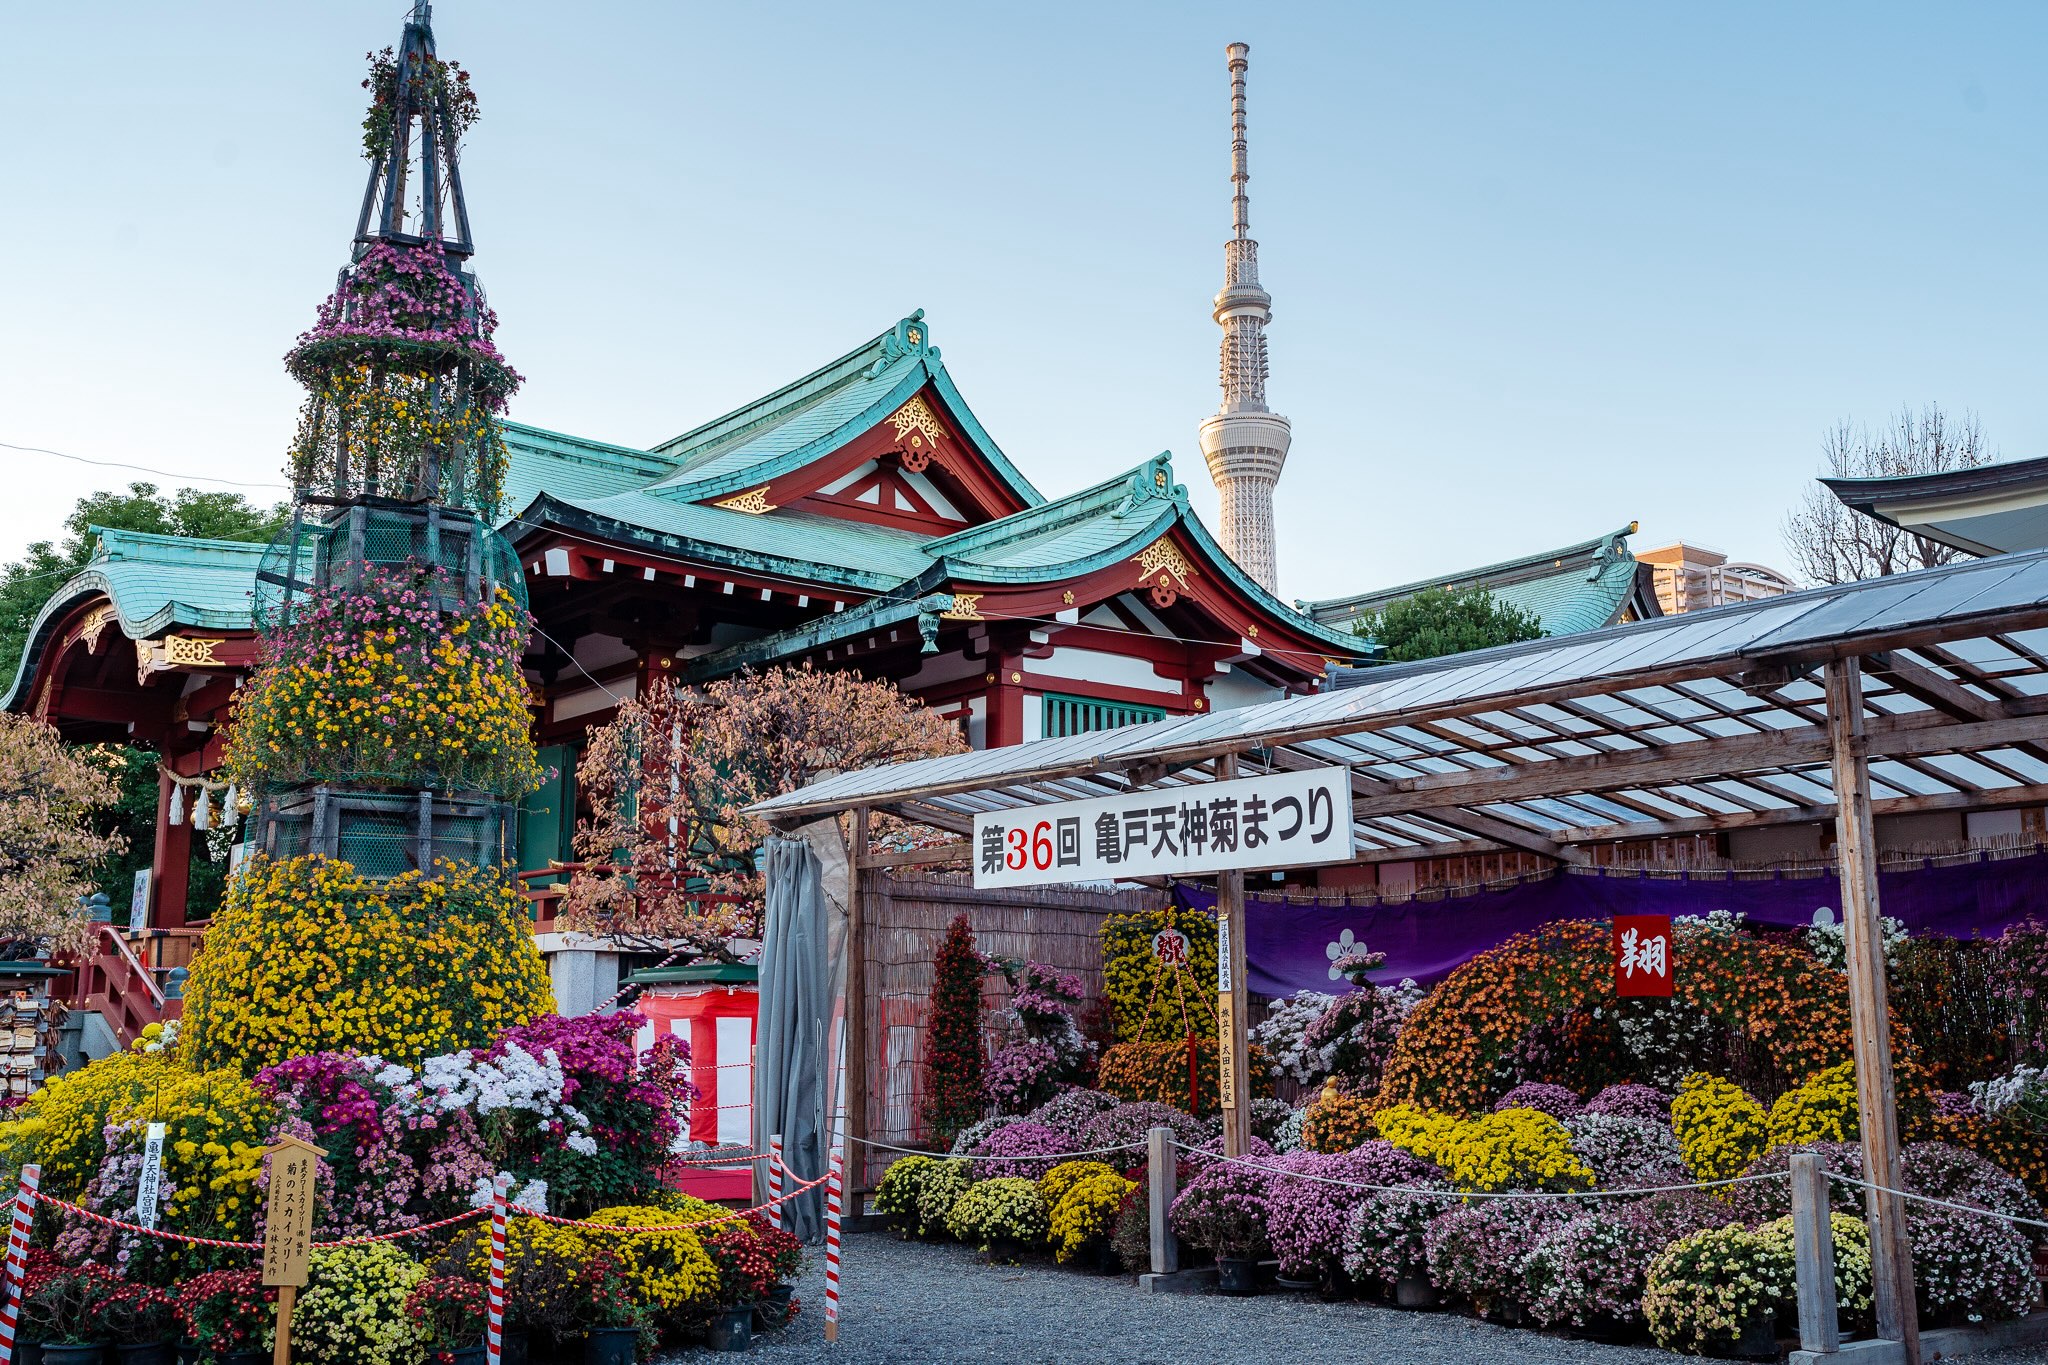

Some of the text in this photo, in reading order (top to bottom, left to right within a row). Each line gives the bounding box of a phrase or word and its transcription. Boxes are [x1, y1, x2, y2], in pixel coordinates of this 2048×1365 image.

[981, 786, 1334, 874] 第36回 亀戸天神菊まつり
[1157, 935, 1185, 963] 祝
[1620, 927, 1666, 979] 翔
[1221, 1008, 1230, 1038] 旅立ち
[283, 1162, 297, 1273] 菊のスカイツリー
